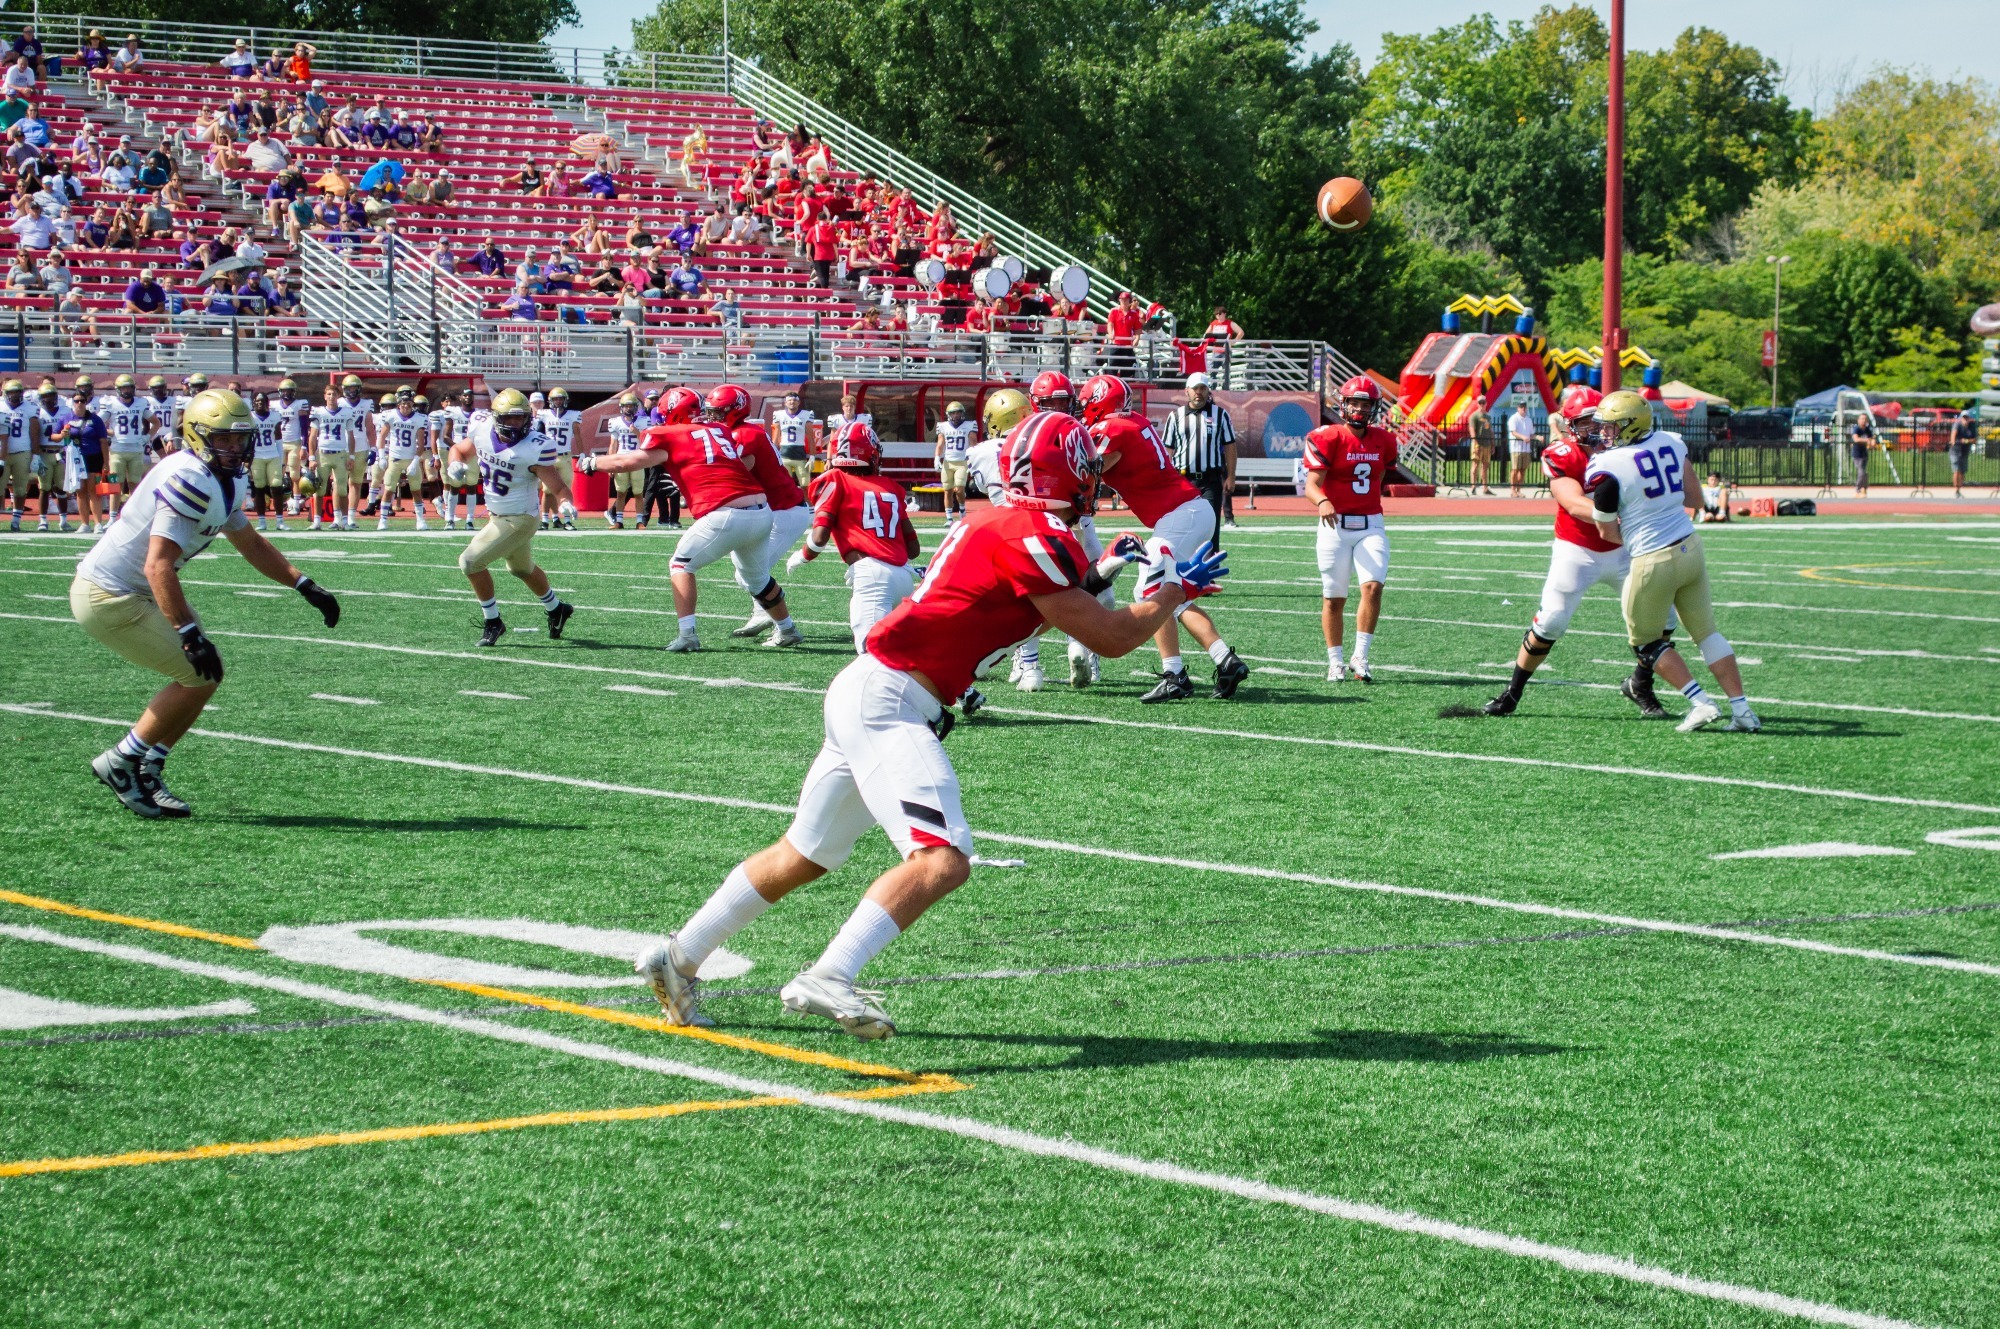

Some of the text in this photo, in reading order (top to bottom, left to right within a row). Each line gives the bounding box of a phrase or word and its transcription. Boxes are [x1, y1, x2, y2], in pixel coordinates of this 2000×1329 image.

[118, 415, 139, 435] 84
[324, 424, 342, 440] 14
[255, 429, 272, 446] 18
[395, 428, 411, 447] 19
[622, 434, 638, 450] 15
[788, 426, 797, 442] 6
[691, 428, 737, 464] 75
[946, 436, 966, 451] 20
[479, 449, 516, 471] ALBION
[1346, 452, 1380, 461] CARTHAGE
[1352, 462, 1372, 494] 3
[1633, 445, 1684, 499] 92
[1005, 494, 1047, 510] Riddell
[1754, 499, 1771, 513] 30
[862, 490, 900, 539] 47
